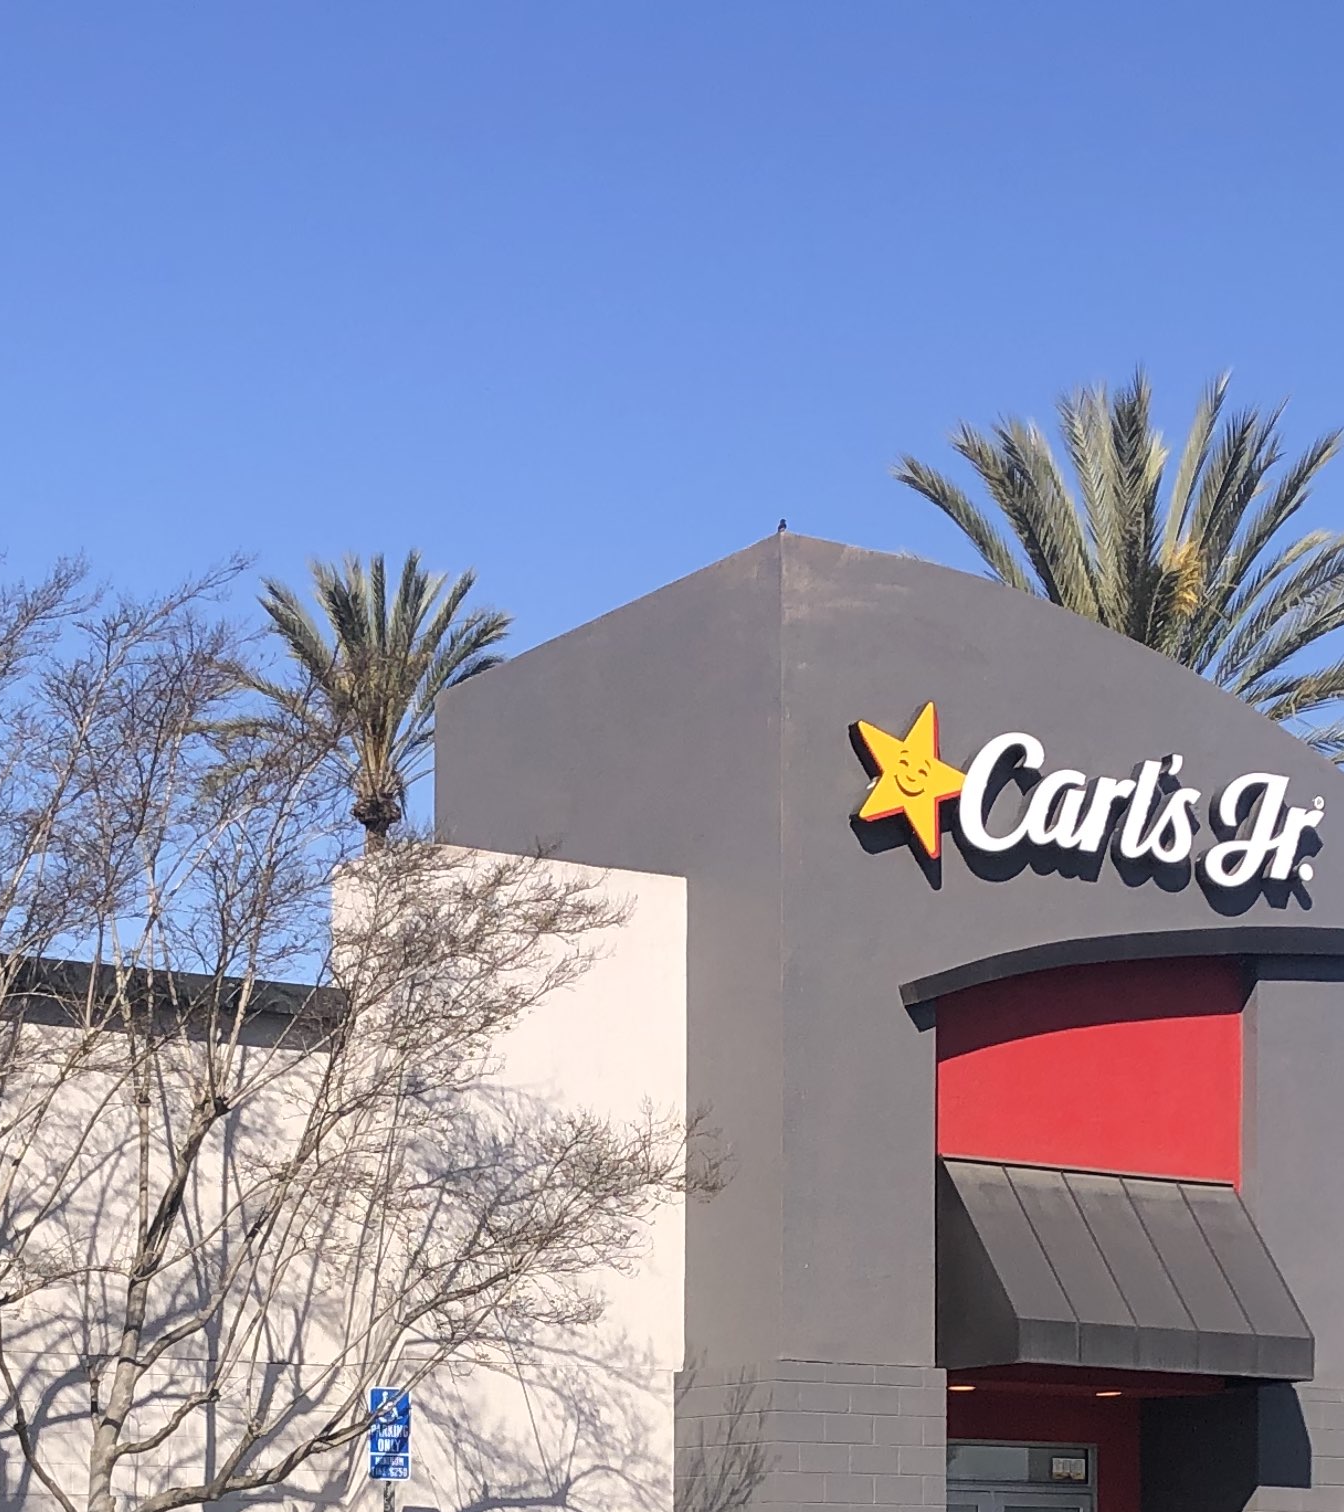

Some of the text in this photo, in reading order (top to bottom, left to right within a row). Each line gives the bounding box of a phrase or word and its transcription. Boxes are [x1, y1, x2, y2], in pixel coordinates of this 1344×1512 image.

[958, 732, 1324, 888] Carl's Jr.
[371, 1424, 409, 1438] PARKING
[377, 1439, 401, 1452] ONLY
